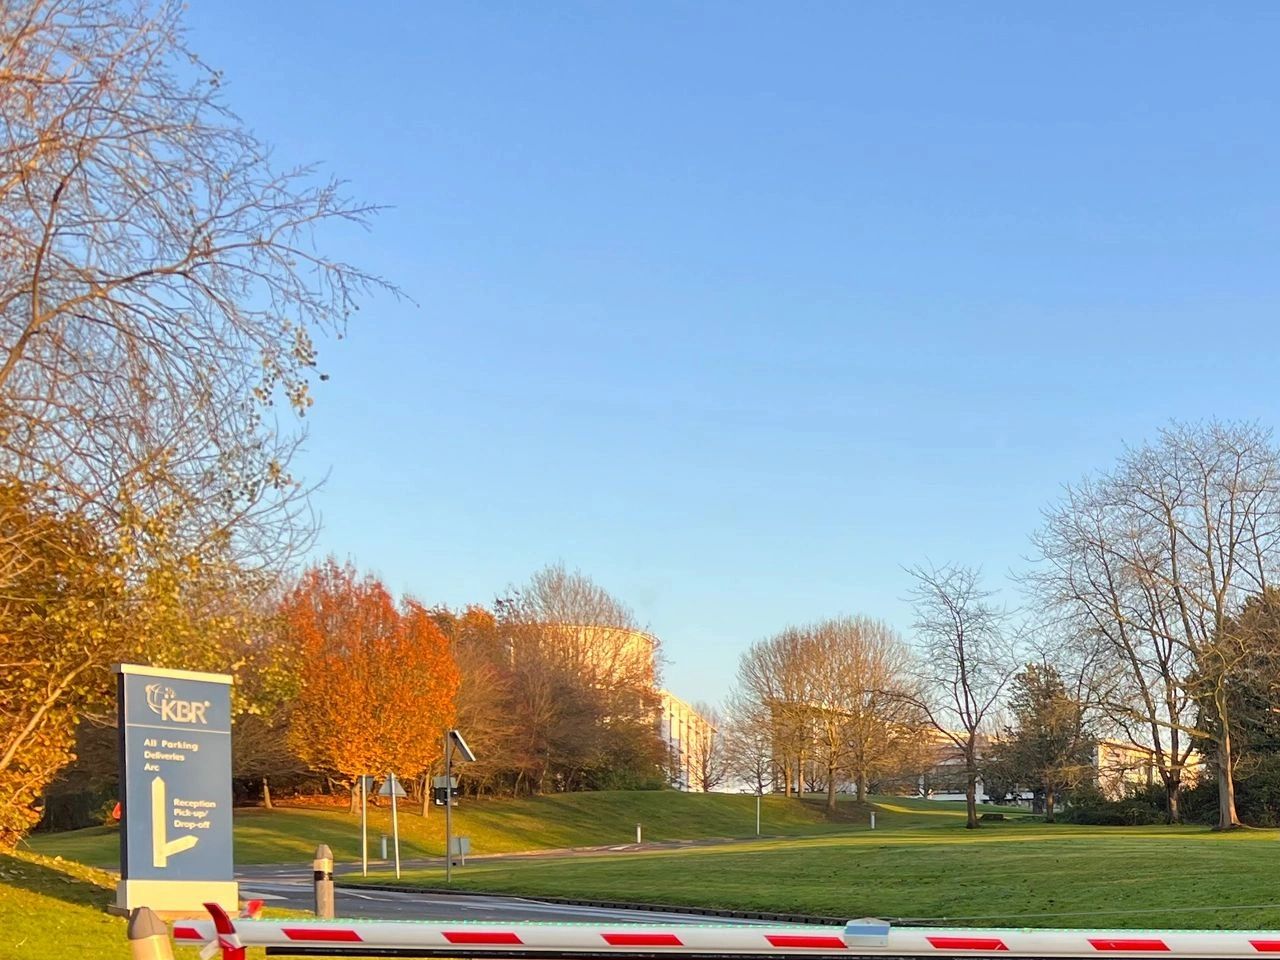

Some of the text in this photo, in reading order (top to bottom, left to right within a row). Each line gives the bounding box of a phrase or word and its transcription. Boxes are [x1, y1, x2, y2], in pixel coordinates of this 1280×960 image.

[144, 739, 198, 751] All Parking
[144, 751, 185, 761] Deliveries
[144, 763, 159, 771] Arc
[174, 799, 216, 808] Reception
[174, 820, 210, 829] Drop-off
